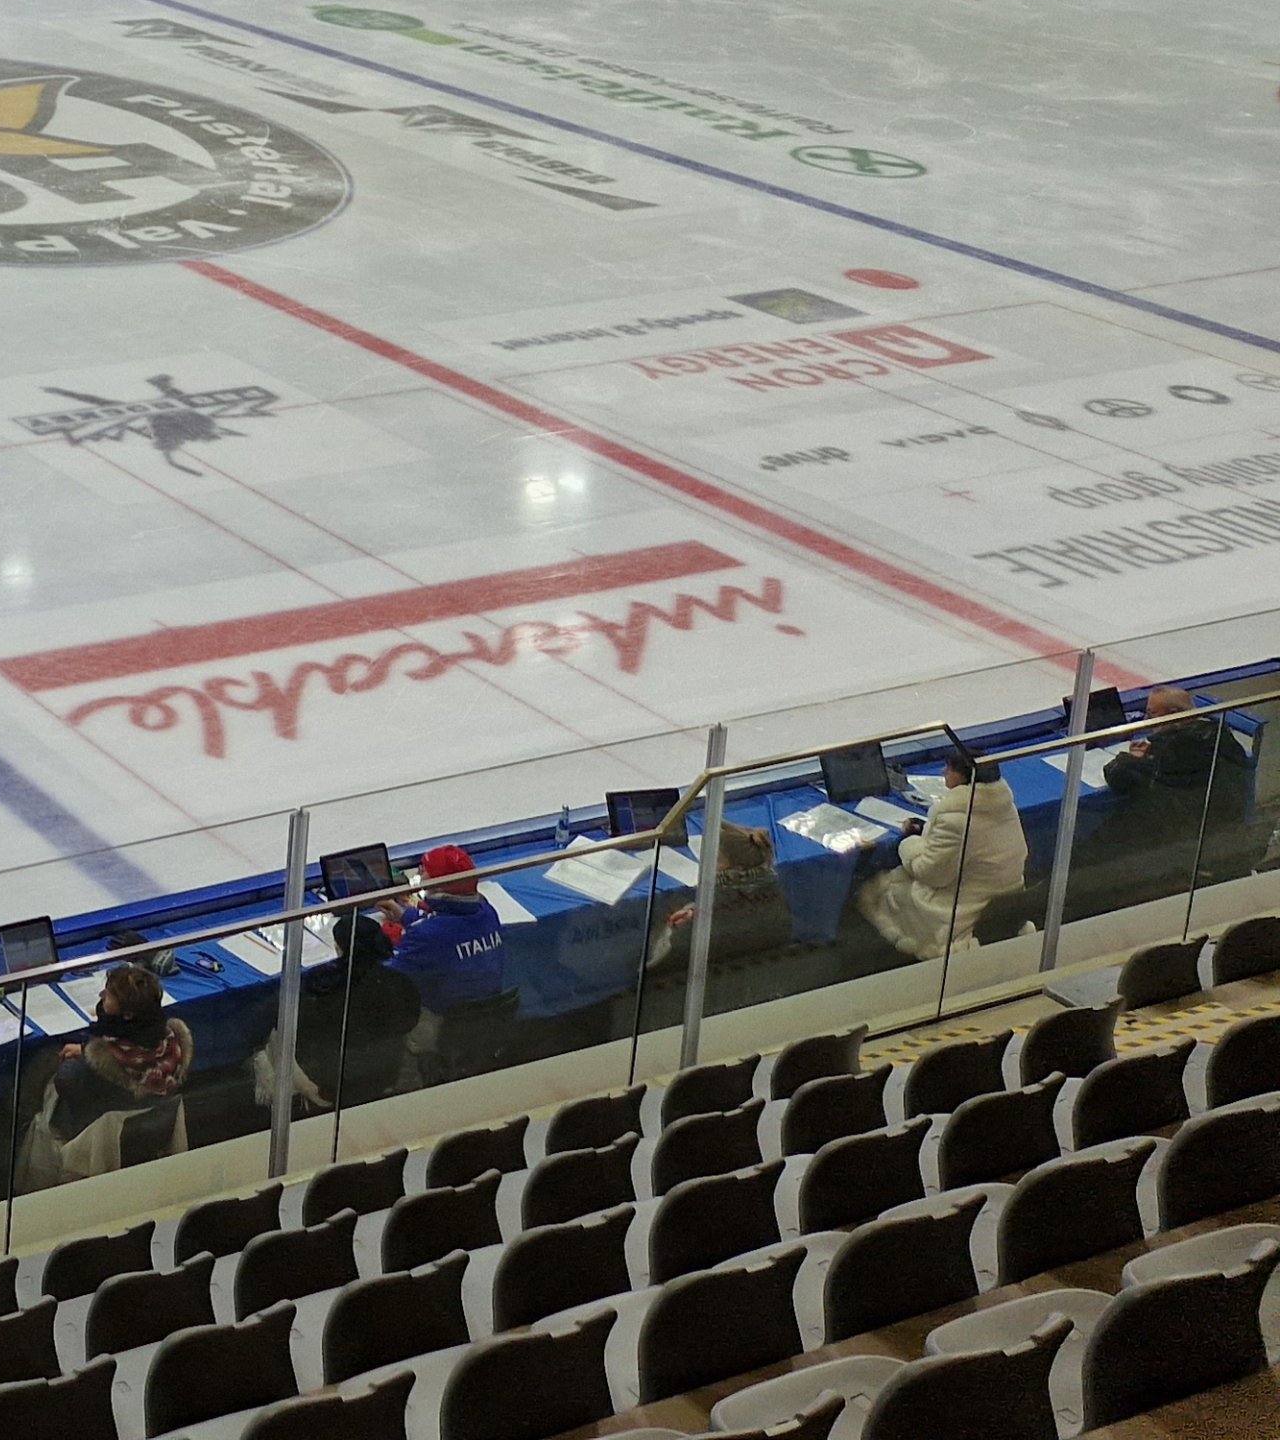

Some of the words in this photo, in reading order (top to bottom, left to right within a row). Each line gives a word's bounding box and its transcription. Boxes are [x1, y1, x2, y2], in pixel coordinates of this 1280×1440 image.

[460, 43, 794, 142] Raiffeisen
[123, 92, 295, 211] Pustertal
[94, 217, 243, 250] Val
[626, 337, 837, 381] ENERGY
[729, 358, 890, 393] CRON
[1045, 471, 1183, 510] group
[68, 576, 808, 759] intercable
[455, 931, 503, 960] ITALIA
